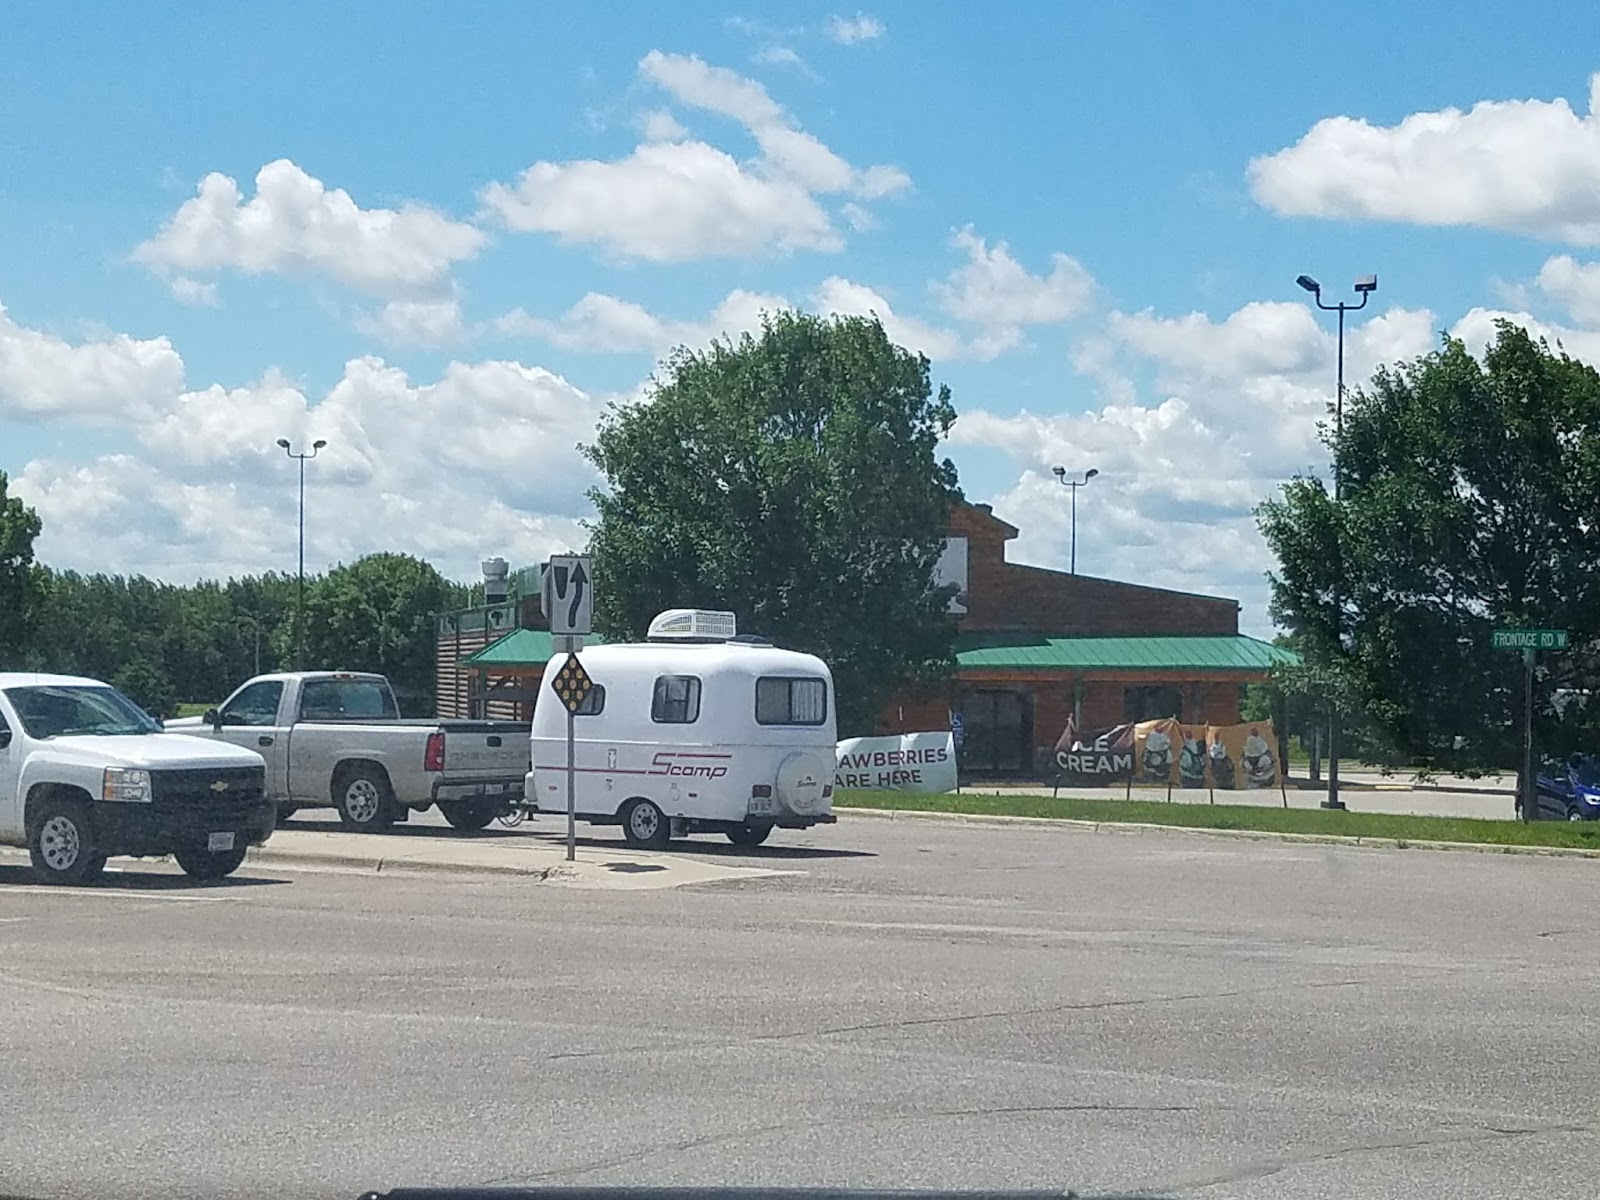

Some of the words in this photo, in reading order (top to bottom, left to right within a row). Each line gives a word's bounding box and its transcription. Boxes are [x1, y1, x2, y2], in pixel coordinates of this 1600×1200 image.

[1494, 632, 1537, 647] FRONTAGE
[1541, 632, 1554, 647] RD
[1557, 632, 1566, 647] W
[648, 753, 728, 780] Scamp
[836, 748, 948, 769] AWBERRIES
[1056, 751, 1132, 773] CREAM
[835, 773, 871, 788] ARE
[878, 769, 922, 787] HERE
